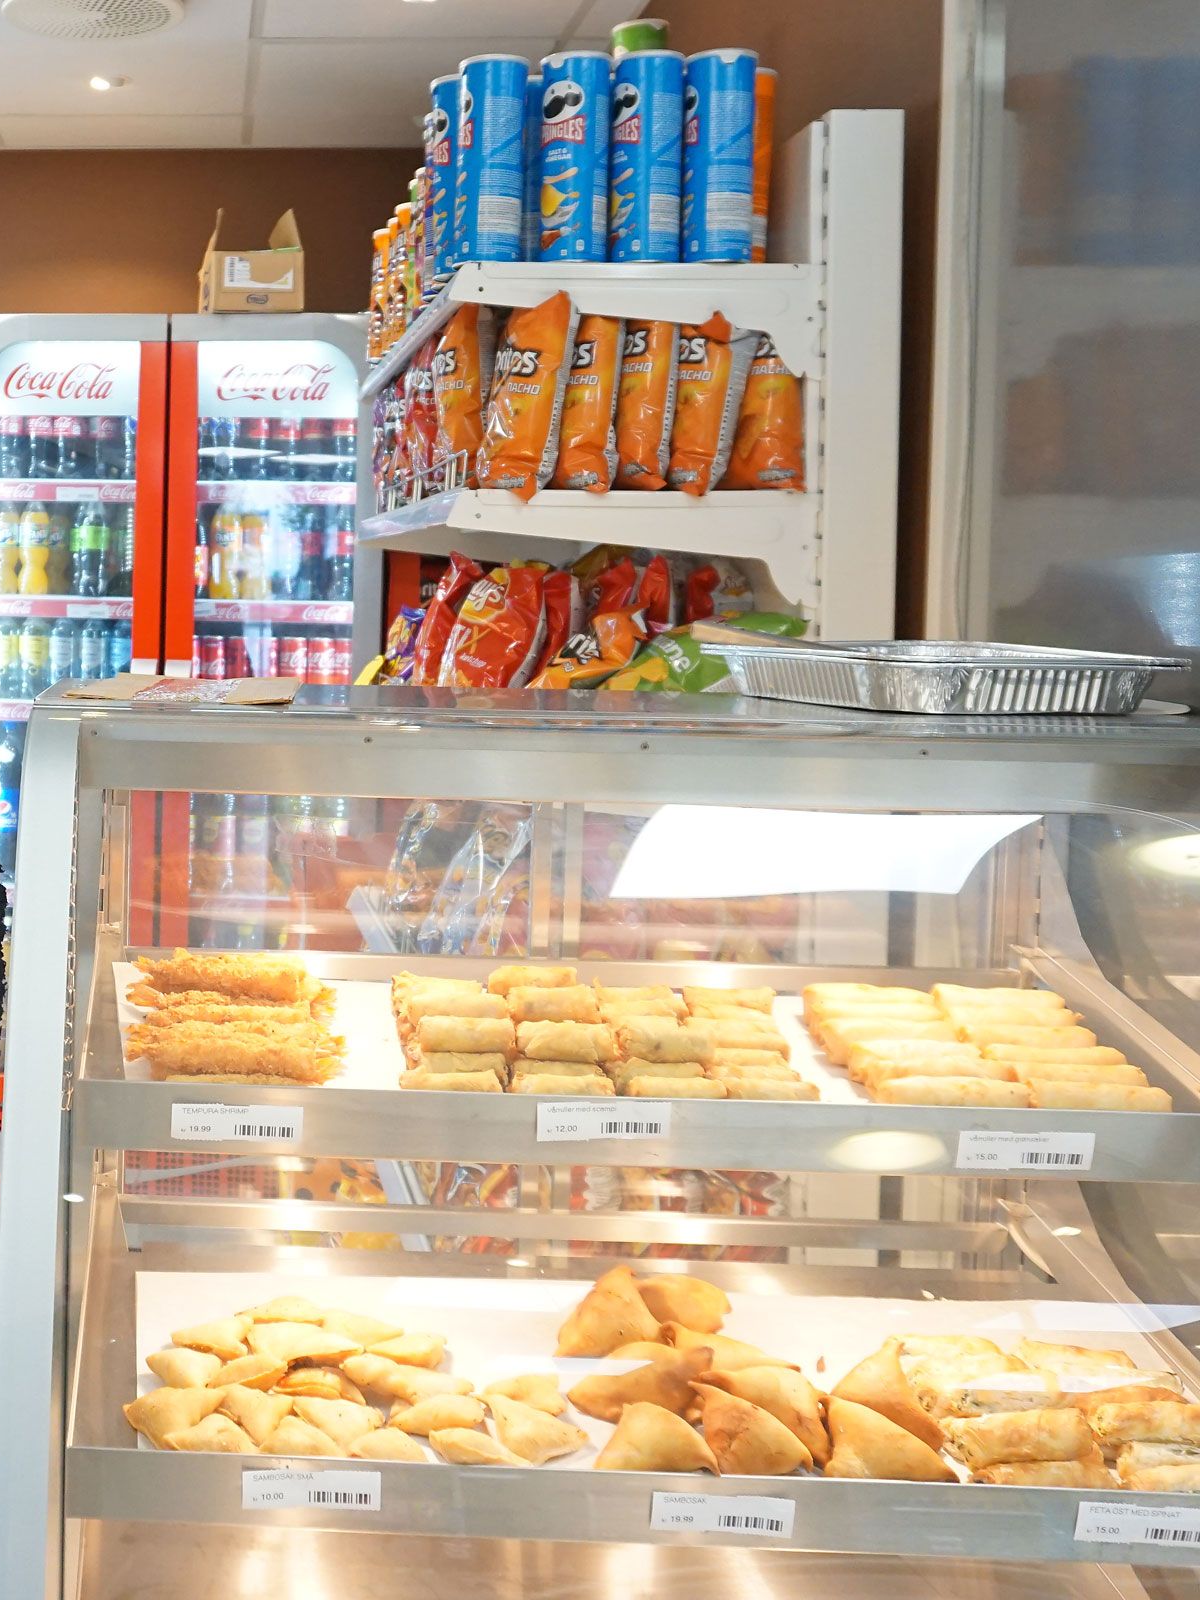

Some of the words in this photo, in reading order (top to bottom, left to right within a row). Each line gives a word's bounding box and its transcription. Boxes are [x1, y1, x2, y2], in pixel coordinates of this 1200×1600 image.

[3, 362, 116, 399] Coca-Cola
[182, 1107, 218, 1115] TEMPURA
[556, 1125, 577, 1133] 12.00
[975, 1153, 998, 1161] 15.00
[261, 1492, 284, 1501] 10.00
[1089, 1506, 1111, 1514] FETA
[1112, 1507, 1129, 1515] OST
[1131, 1509, 1150, 1517] MED
[670, 1515, 694, 1523] 19.99
[1095, 1526, 1120, 1534] 15.00
